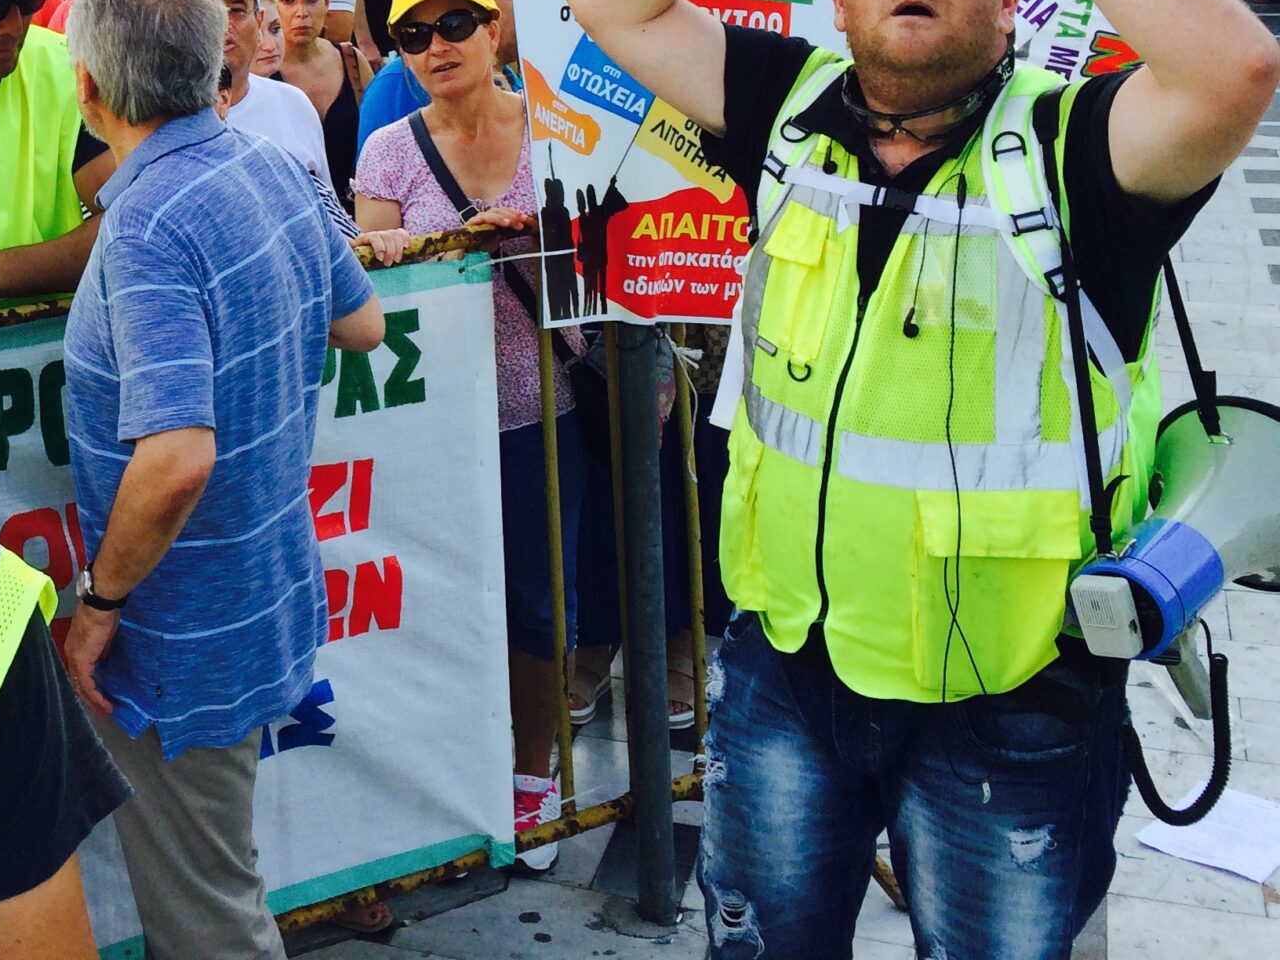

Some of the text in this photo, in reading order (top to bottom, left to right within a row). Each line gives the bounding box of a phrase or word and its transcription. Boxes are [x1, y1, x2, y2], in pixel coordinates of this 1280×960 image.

[602, 63, 622, 79] στη
[567, 62, 647, 118] ΦΤΩΧΕΙΑ
[533, 102, 586, 149] ΑΝΕΡΓΙΑ
[627, 253, 656, 268] την
[623, 272, 685, 297] αδικιών
[690, 281, 719, 294] των
